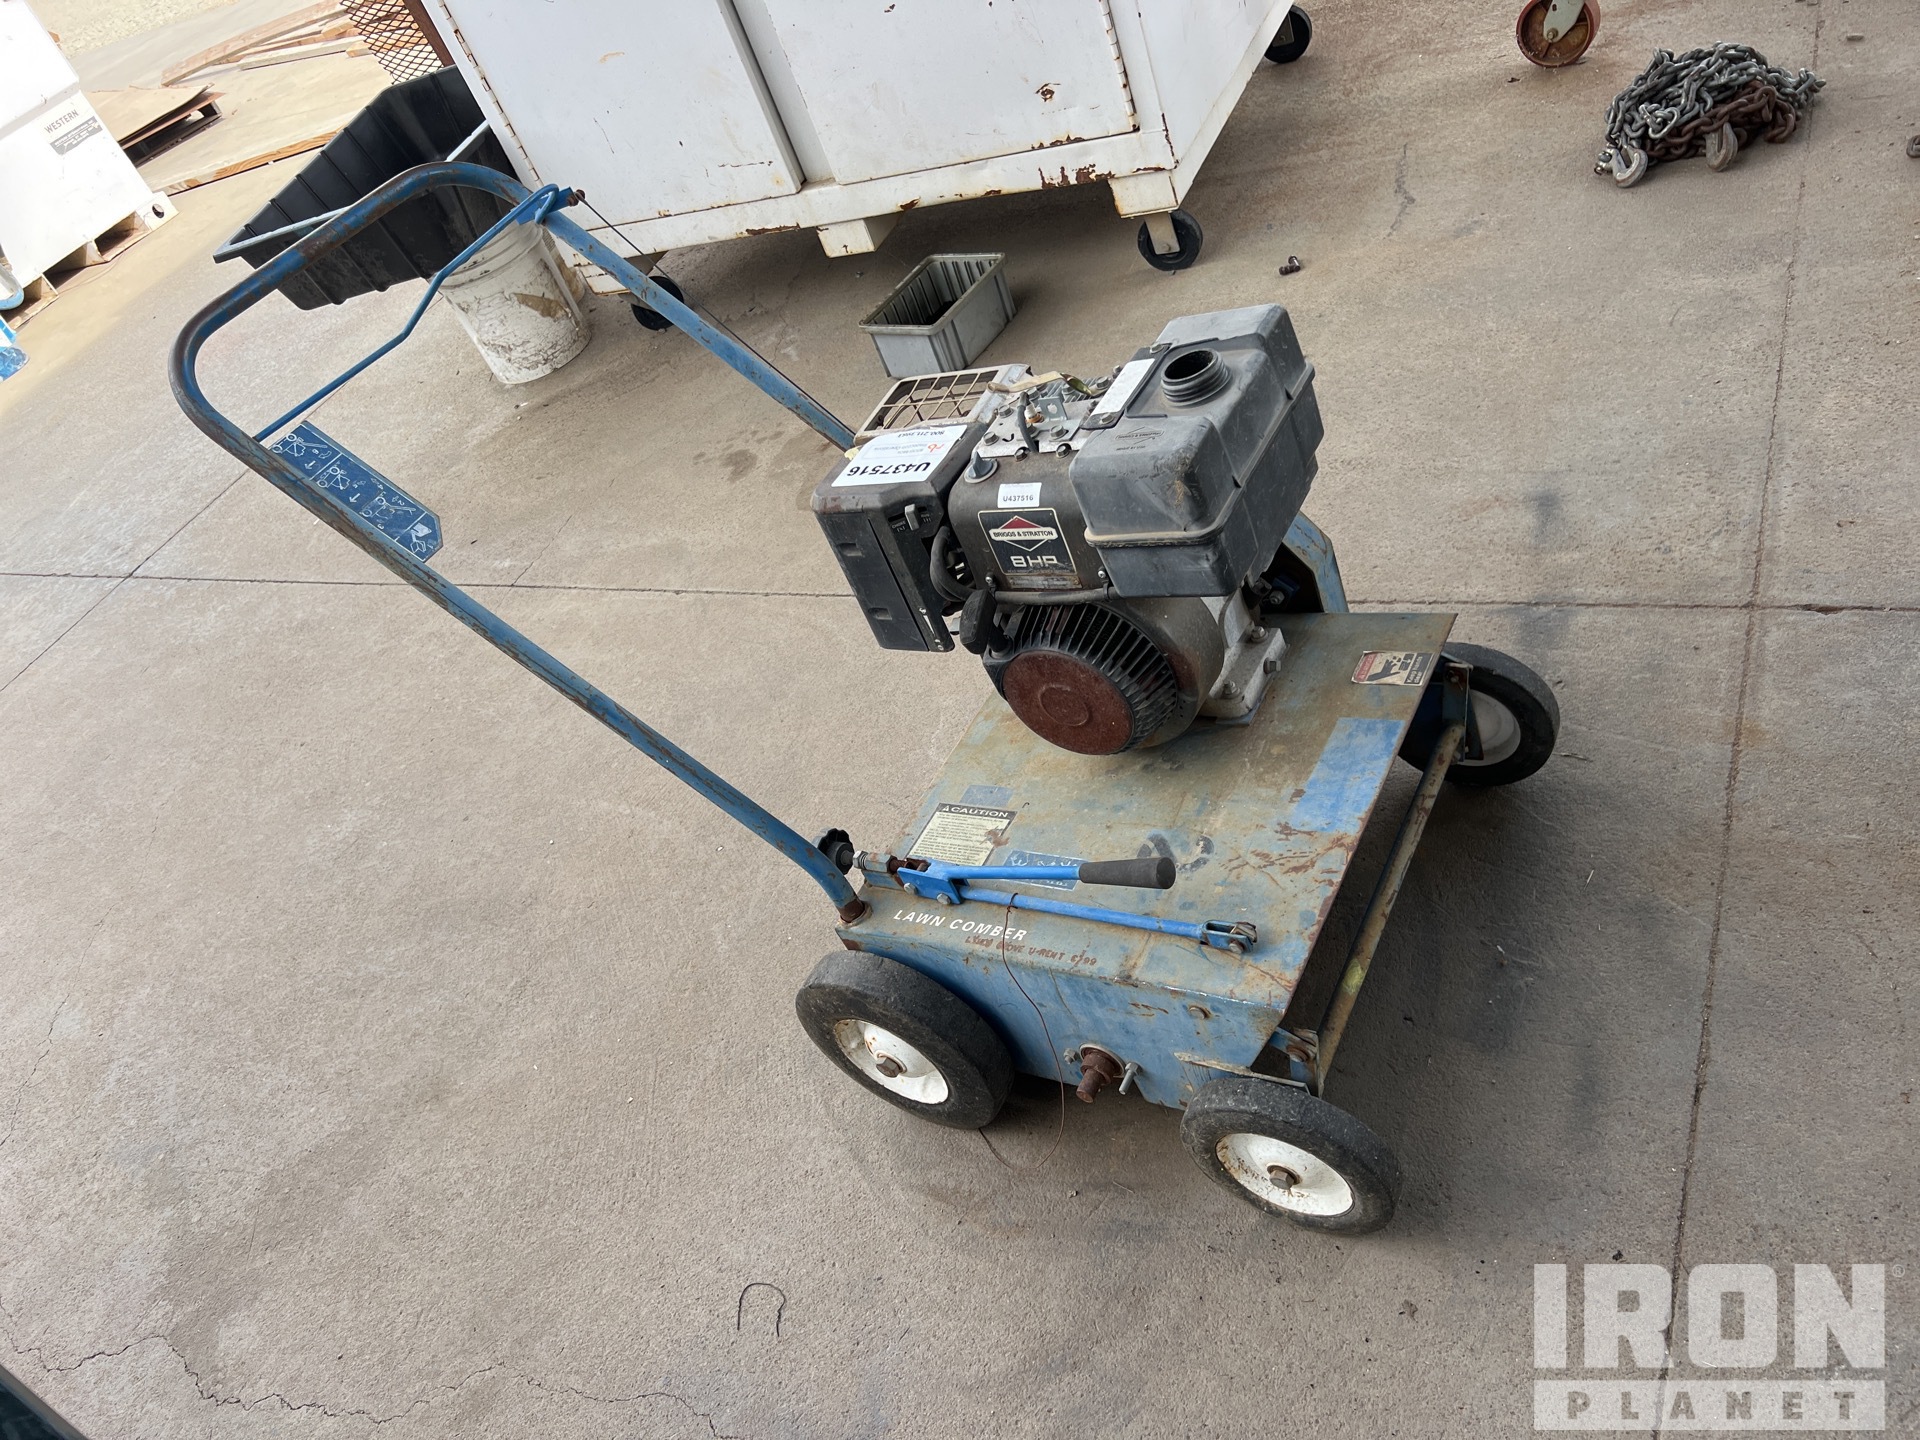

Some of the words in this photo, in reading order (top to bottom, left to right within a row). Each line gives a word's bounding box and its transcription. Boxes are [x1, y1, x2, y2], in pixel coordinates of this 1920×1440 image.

[43, 109, 79, 134] WESTERN
[847, 461, 931, 477] U437516
[1002, 494, 1034, 502] U437516
[993, 530, 1016, 538] BRIGGS
[950, 806, 1009, 818] CAUTION
[893, 909, 946, 927] LAWN
[949, 918, 1028, 941] COMBER
